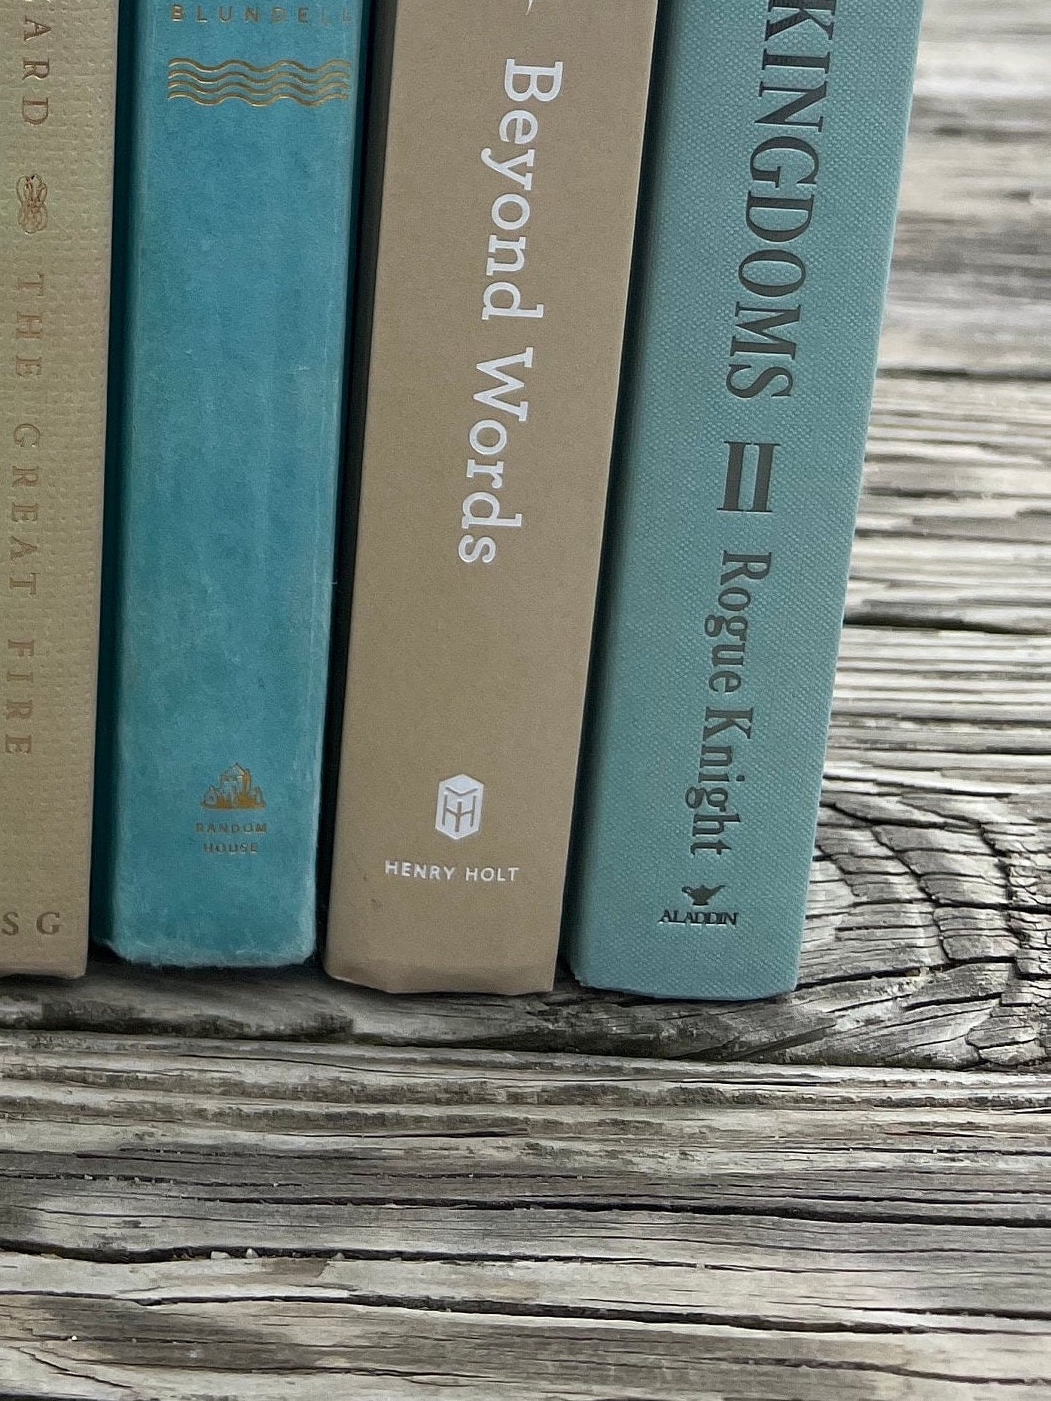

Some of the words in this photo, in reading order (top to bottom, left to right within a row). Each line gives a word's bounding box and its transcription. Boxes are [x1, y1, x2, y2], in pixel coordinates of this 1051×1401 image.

[481, 59, 564, 321] Beyond
[14, 274, 45, 379] THE
[9, 422, 42, 596] GREAT
[458, 346, 534, 564] Words
[703, 549, 773, 694] Rogue
[4, 638, 36, 757] FIRE
[196, 823, 267, 834] RANDOM
[684, 706, 753, 857] Knight
[203, 842, 259, 854] HOUSE
[385, 860, 455, 880] HENRY
[465, 867, 520, 881] HOLT
[657, 910, 739, 925] ALADDIN
